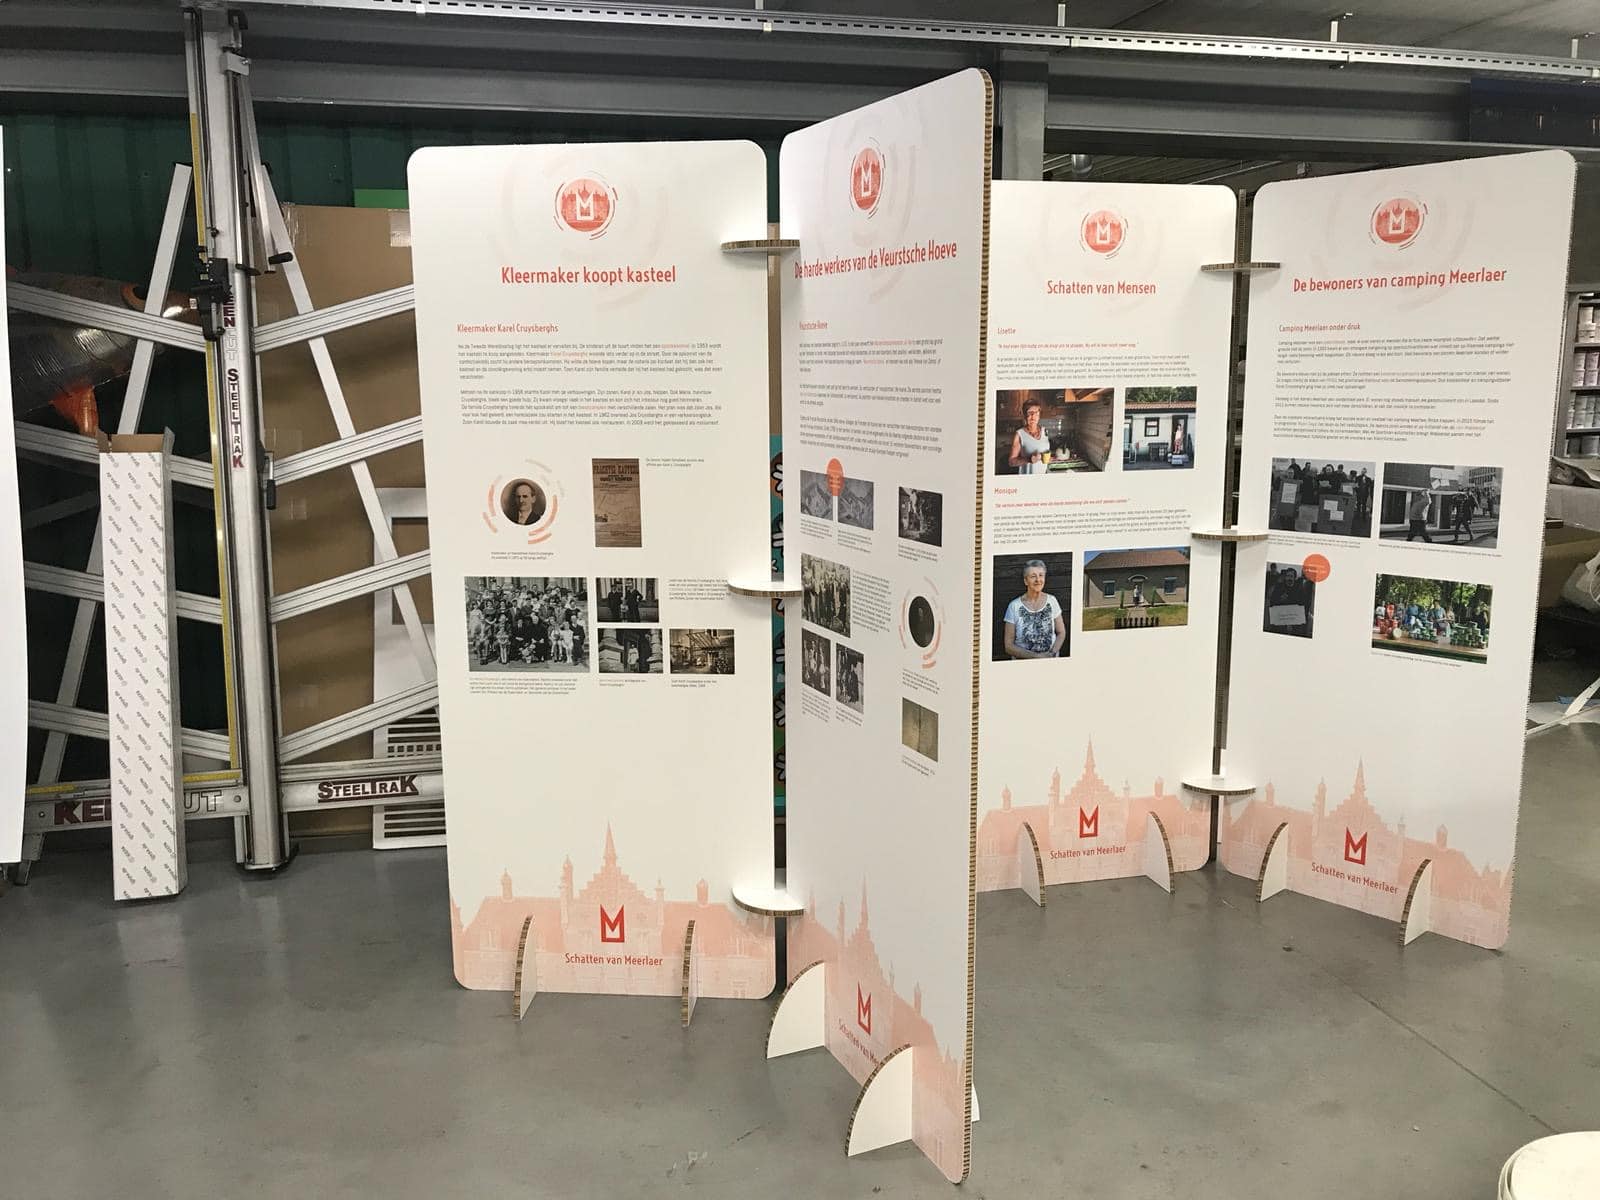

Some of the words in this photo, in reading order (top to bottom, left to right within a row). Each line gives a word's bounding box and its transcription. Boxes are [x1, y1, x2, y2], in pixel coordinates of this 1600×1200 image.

[795, 262, 802, 278] De
[804, 260, 823, 277] harde
[824, 256, 851, 275] werkers
[853, 256, 866, 271] van
[868, 250, 878, 268] de
[880, 245, 926, 266] Veurstsche
[929, 240, 957, 260] Hoeve
[502, 266, 580, 284] Kleermaker
[583, 267, 622, 286] koopt
[626, 266, 676, 283] kasteel
[1294, 278, 1306, 292] De
[1310, 277, 1363, 292] bewoners
[1366, 275, 1387, 288] van
[1391, 272, 1445, 291] camping
[1449, 267, 1507, 284] Meerlaer
[1047, 280, 1092, 294] Schatten
[1096, 283, 1114, 294] van
[1118, 282, 1156, 294] Mensen
[457, 324, 496, 334] Kleermaker
[498, 324, 515, 334] Karel
[516, 324, 558, 336] Cruysberghs
[1279, 324, 1303, 332] Camping
[994, 487, 1018, 496] Monique
[318, 775, 419, 803] STEELTRAK
[1050, 848, 1081, 860] Schatten
[1097, 845, 1126, 856] Meerlaer
[1312, 862, 1345, 879] Schatten
[1347, 873, 1361, 884] van
[1363, 876, 1398, 894] Meerlaer
[565, 952, 604, 965] Schatten
[607, 956, 622, 965] van
[624, 955, 663, 966] Meerlaer
